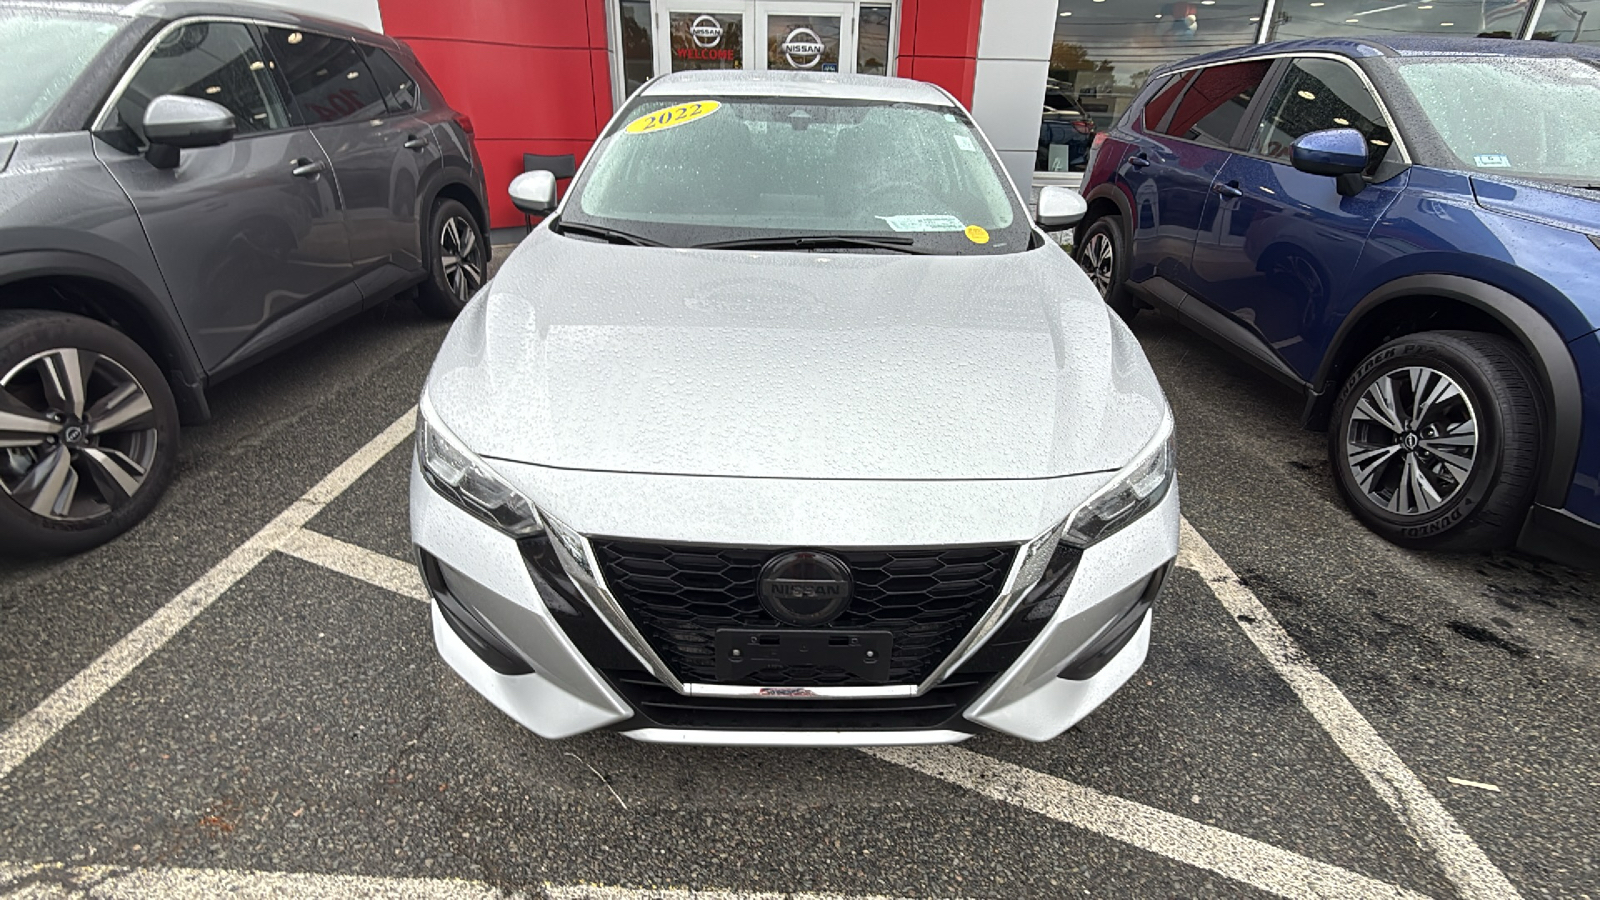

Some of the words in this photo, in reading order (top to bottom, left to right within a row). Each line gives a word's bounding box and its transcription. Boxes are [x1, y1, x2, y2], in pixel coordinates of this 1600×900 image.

[676, 48, 734, 60] WELCOME
[786, 45, 821, 53] NISSAN
[643, 103, 702, 130] 2022
[771, 584, 840, 596] NISSAN
